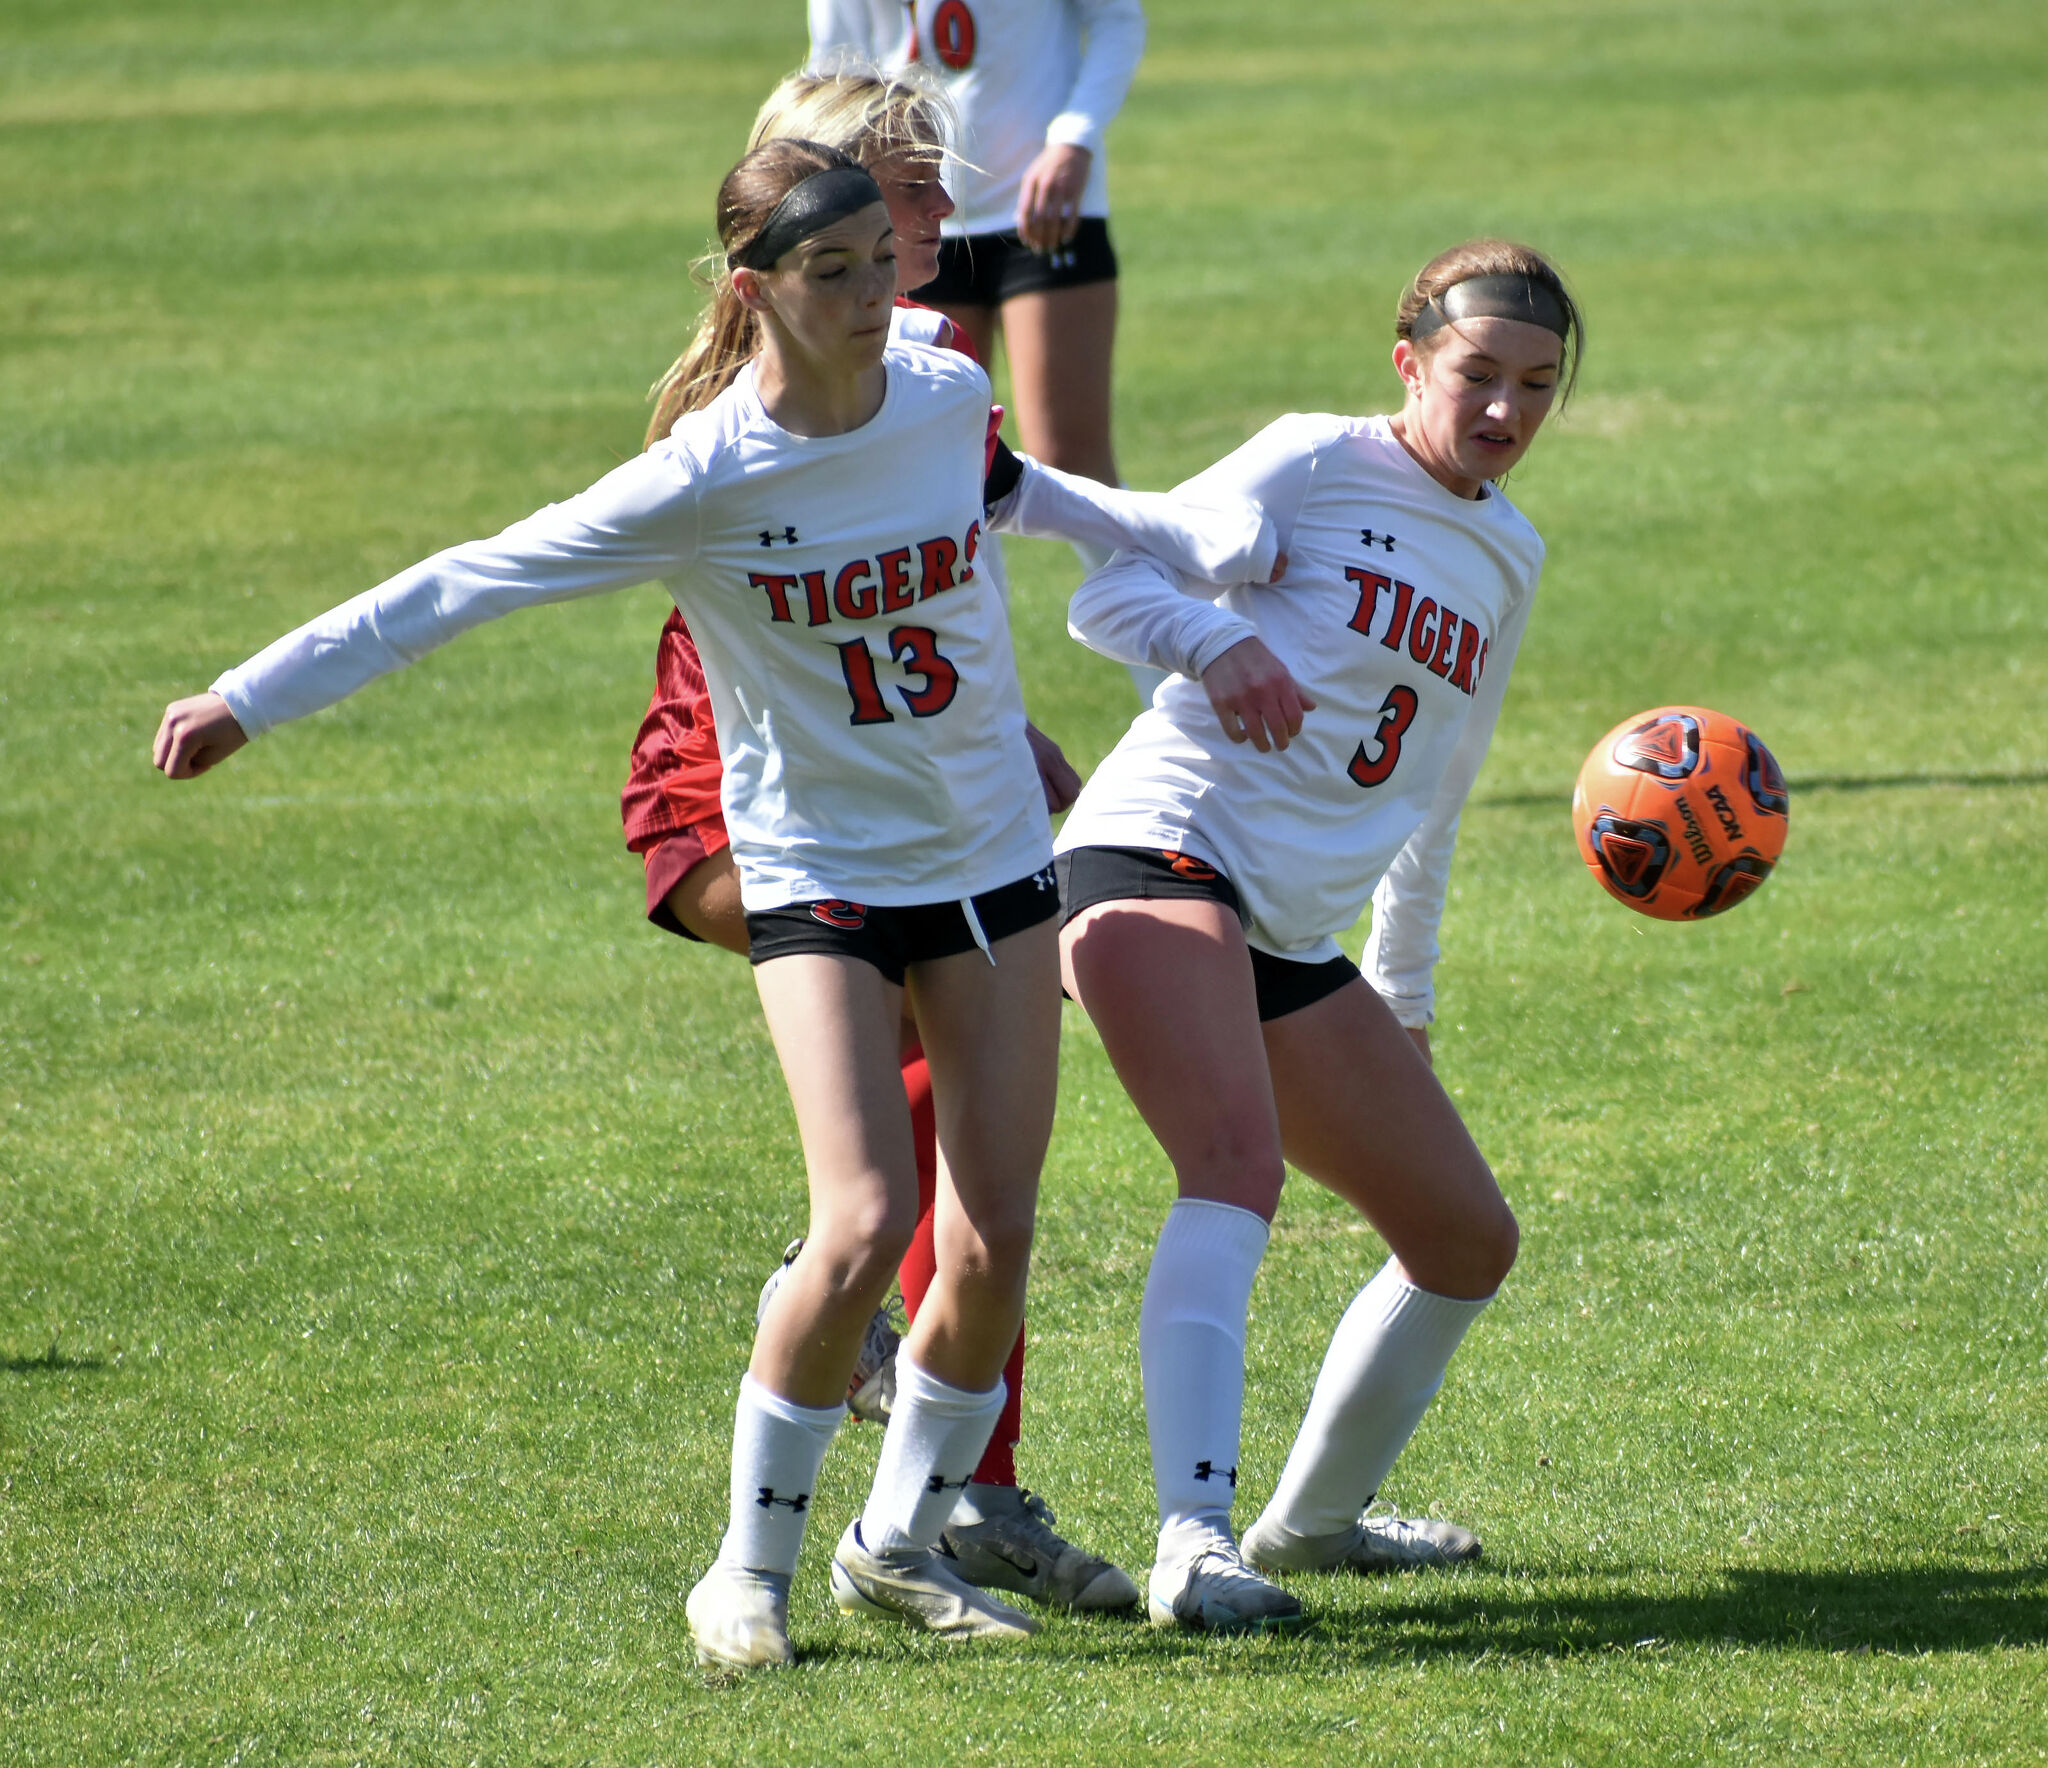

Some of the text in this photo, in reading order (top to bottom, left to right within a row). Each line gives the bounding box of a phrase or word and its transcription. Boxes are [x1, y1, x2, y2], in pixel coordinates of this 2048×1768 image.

[837, 625, 959, 726] 13
[1346, 684, 1418, 788] 3
[1675, 796, 1713, 864] Wilson
[1706, 785, 1743, 841] NCAA
